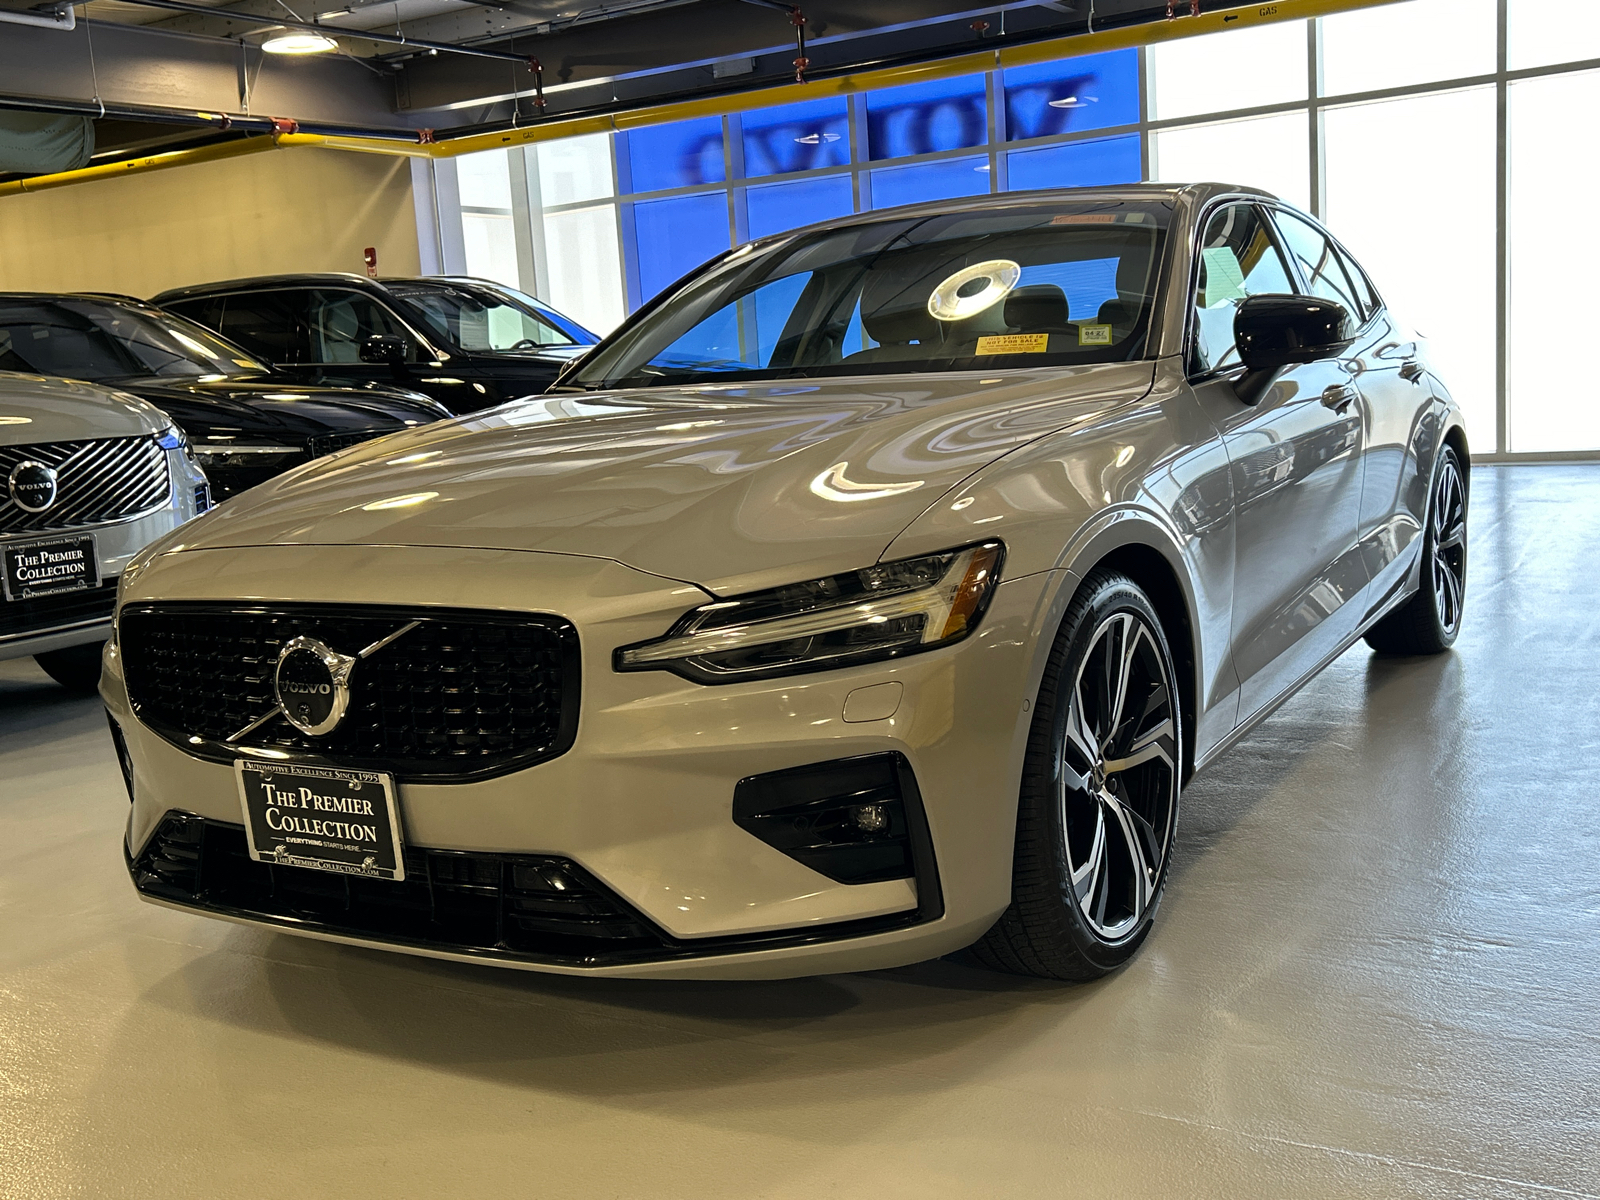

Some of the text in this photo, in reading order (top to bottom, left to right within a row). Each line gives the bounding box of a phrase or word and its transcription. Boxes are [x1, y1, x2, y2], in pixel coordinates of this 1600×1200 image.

[1259, 6, 1278, 17] GAS
[18, 481, 53, 491] VOLVO
[37, 538, 64, 548] EXCELLENCE
[14, 549, 84, 568] THE PREMIER
[16, 562, 86, 581] COLLECTION
[280, 680, 331, 695] VOLVO
[245, 762, 379, 783] AUTOMOTIVE EXCELLENCE SINCE 1995
[261, 783, 375, 816] THE PREMIER
[265, 807, 378, 844] COLLECTION
[285, 836, 323, 847] EVERYTHING
[323, 841, 344, 850] STARTS
